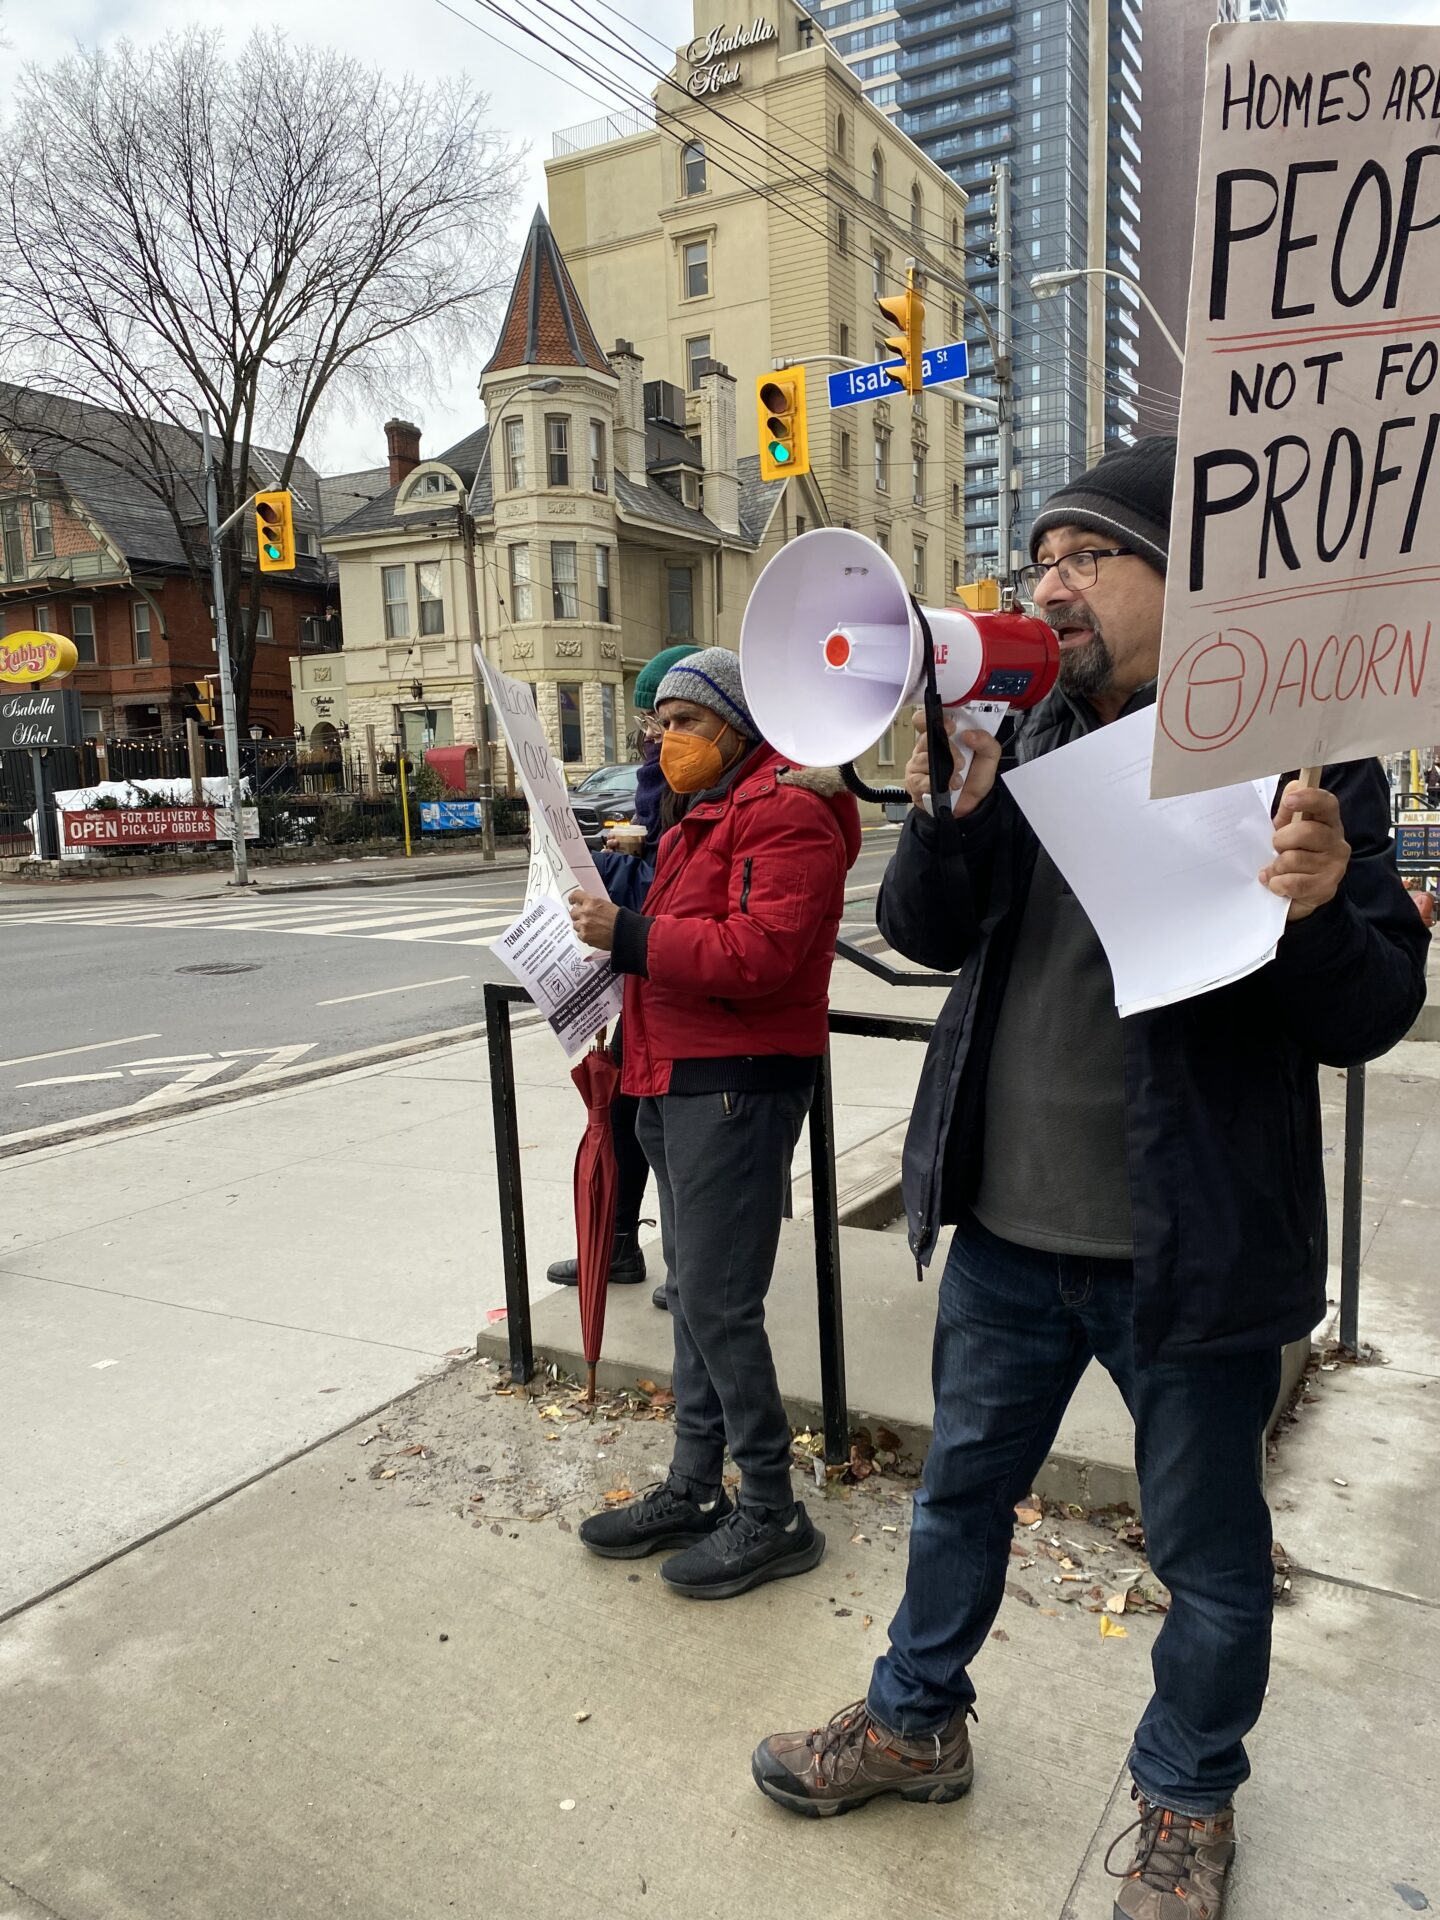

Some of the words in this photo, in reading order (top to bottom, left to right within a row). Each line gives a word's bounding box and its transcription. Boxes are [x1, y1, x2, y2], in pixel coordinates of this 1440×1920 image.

[685, 17, 778, 67] Isabella
[686, 62, 741, 97] Hotel
[1222, 60, 1371, 130] HOMES
[850, 359, 932, 395] Isaba
[937, 351, 948, 363] St
[1230, 352, 1344, 416] NOT
[1269, 621, 1431, 714] ACORN
[3, 696, 55, 718] Isabella
[12, 722, 52, 745] Hotel
[70, 821, 118, 839] OPEN
[121, 812, 142, 823] FOR
[147, 810, 197, 823] DELIVERY
[202, 810, 210, 820] &
[121, 823, 167, 836] PICK-UP
[172, 822, 210, 833] ORDERS
[545, 805, 580, 847] INGS
[1402, 840, 1421, 849] Curry
[1402, 850, 1421, 859] Curry
[504, 924, 527, 948] TENANT
[523, 904, 547, 930] SPEAKOUT!
[512, 941, 530, 961] MEDALLION
[528, 928, 541, 944] TENANTS
